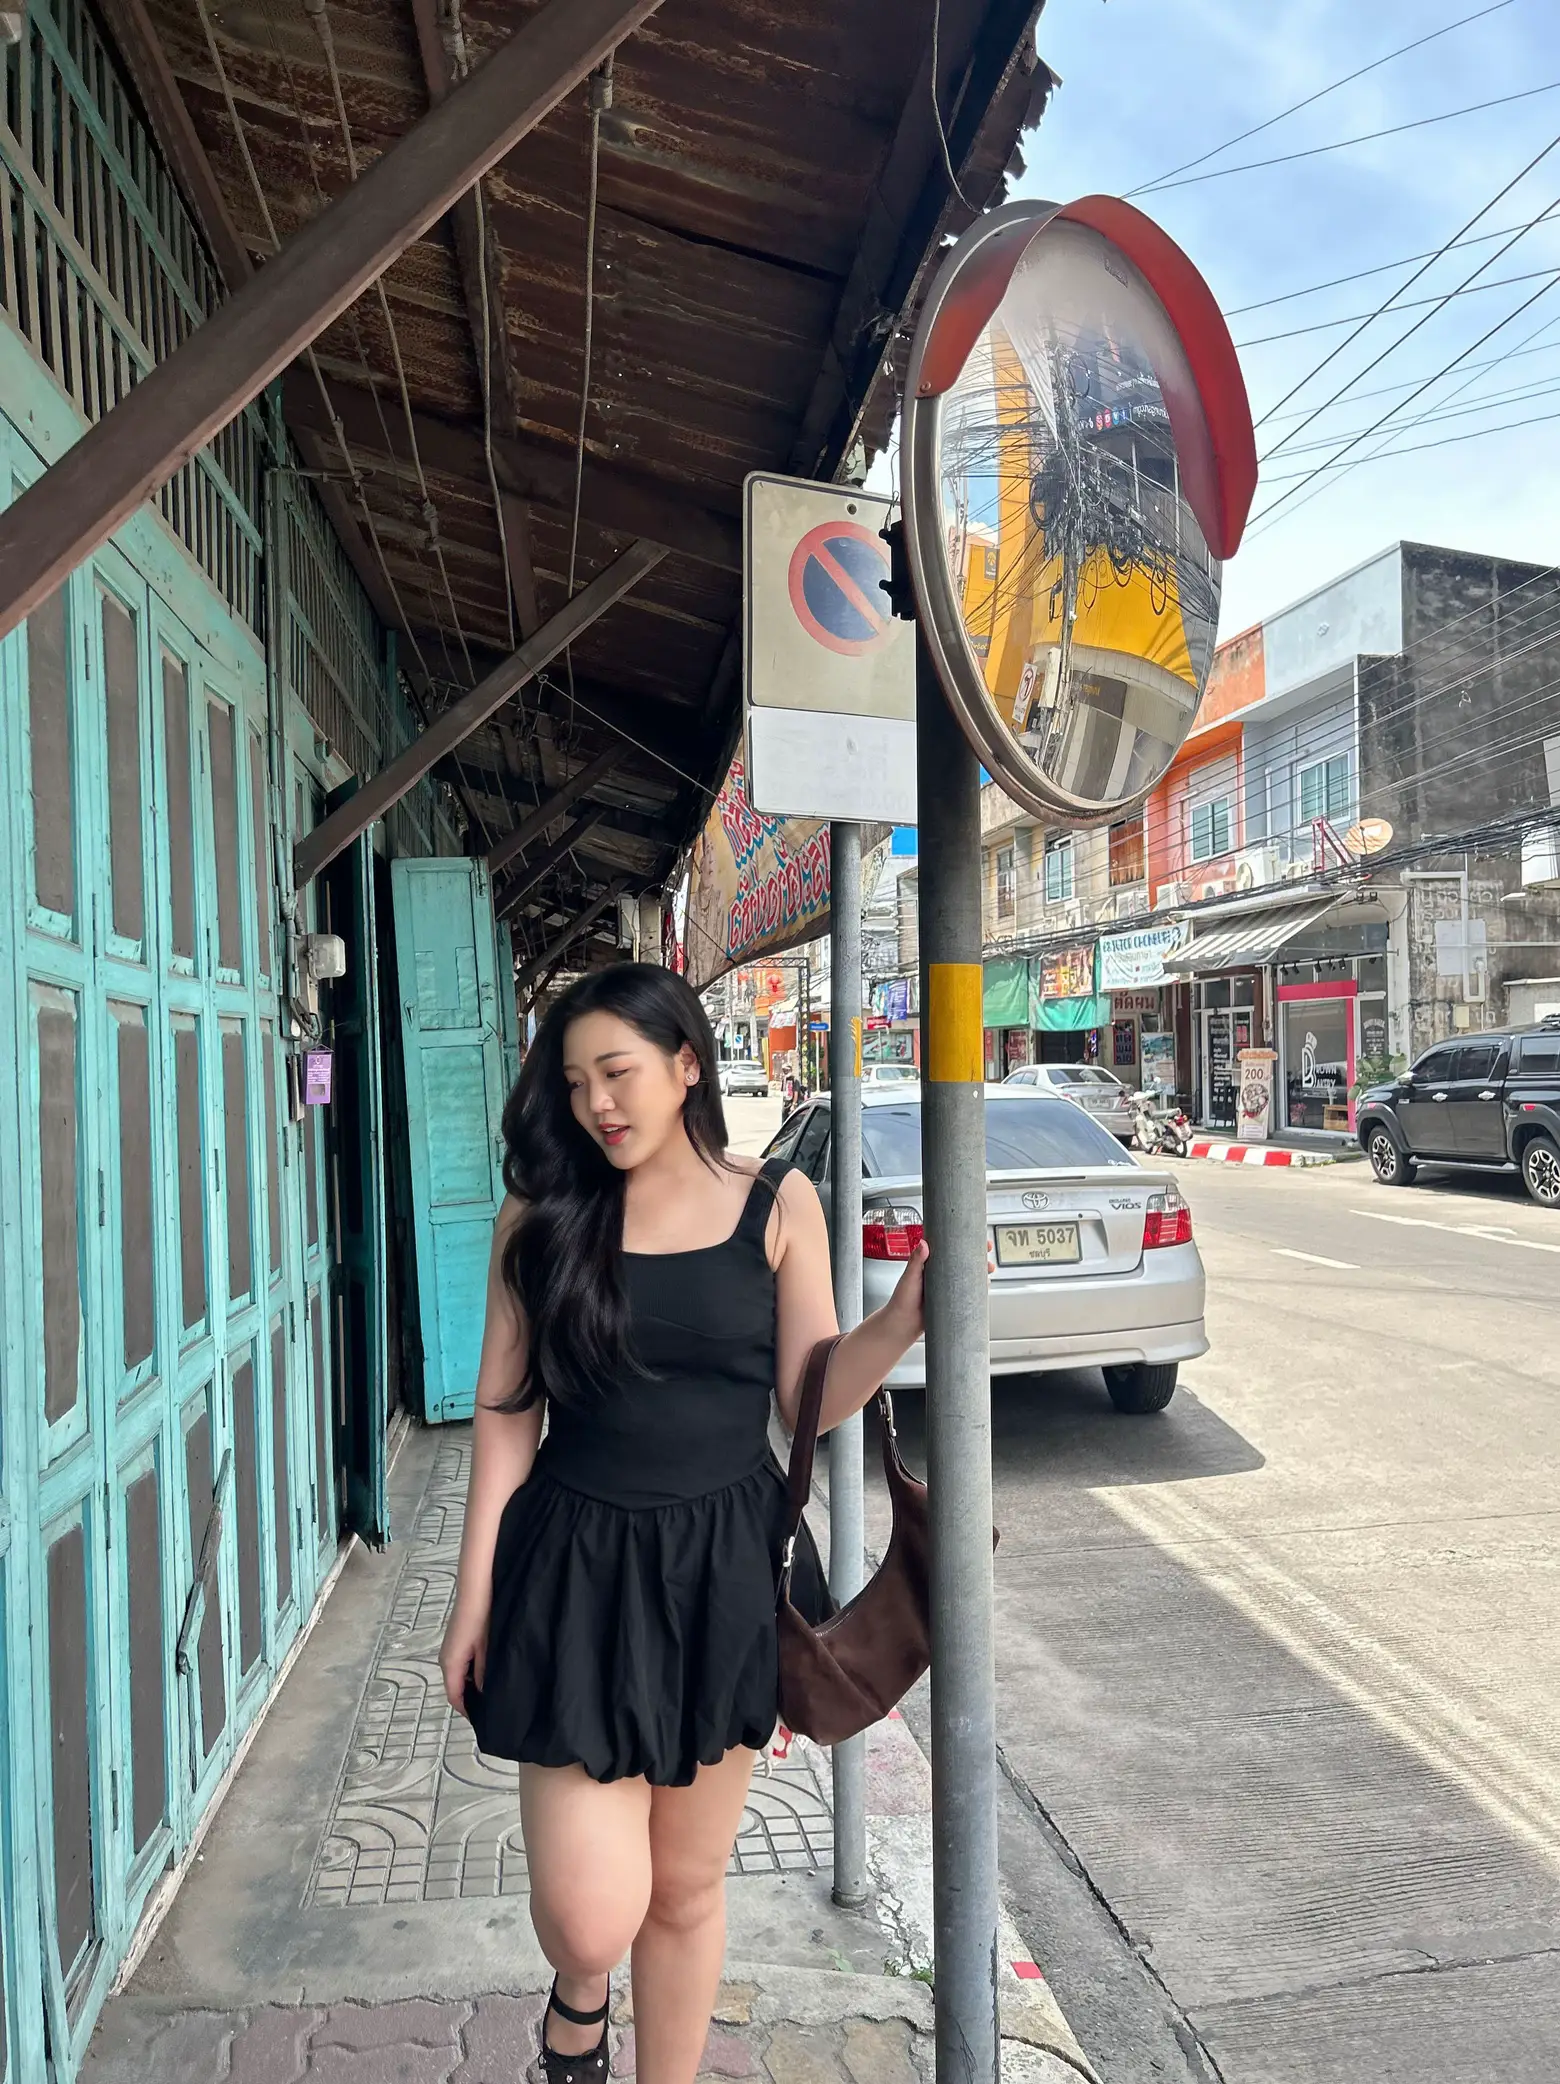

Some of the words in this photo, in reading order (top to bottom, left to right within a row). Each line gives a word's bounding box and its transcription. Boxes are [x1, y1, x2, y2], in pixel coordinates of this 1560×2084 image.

[1245, 1068, 1264, 1080] 200
[1110, 1202, 1142, 1211] VIOS
[1006, 1229, 1029, 1247] จท
[1036, 1227, 1075, 1245] 5037
